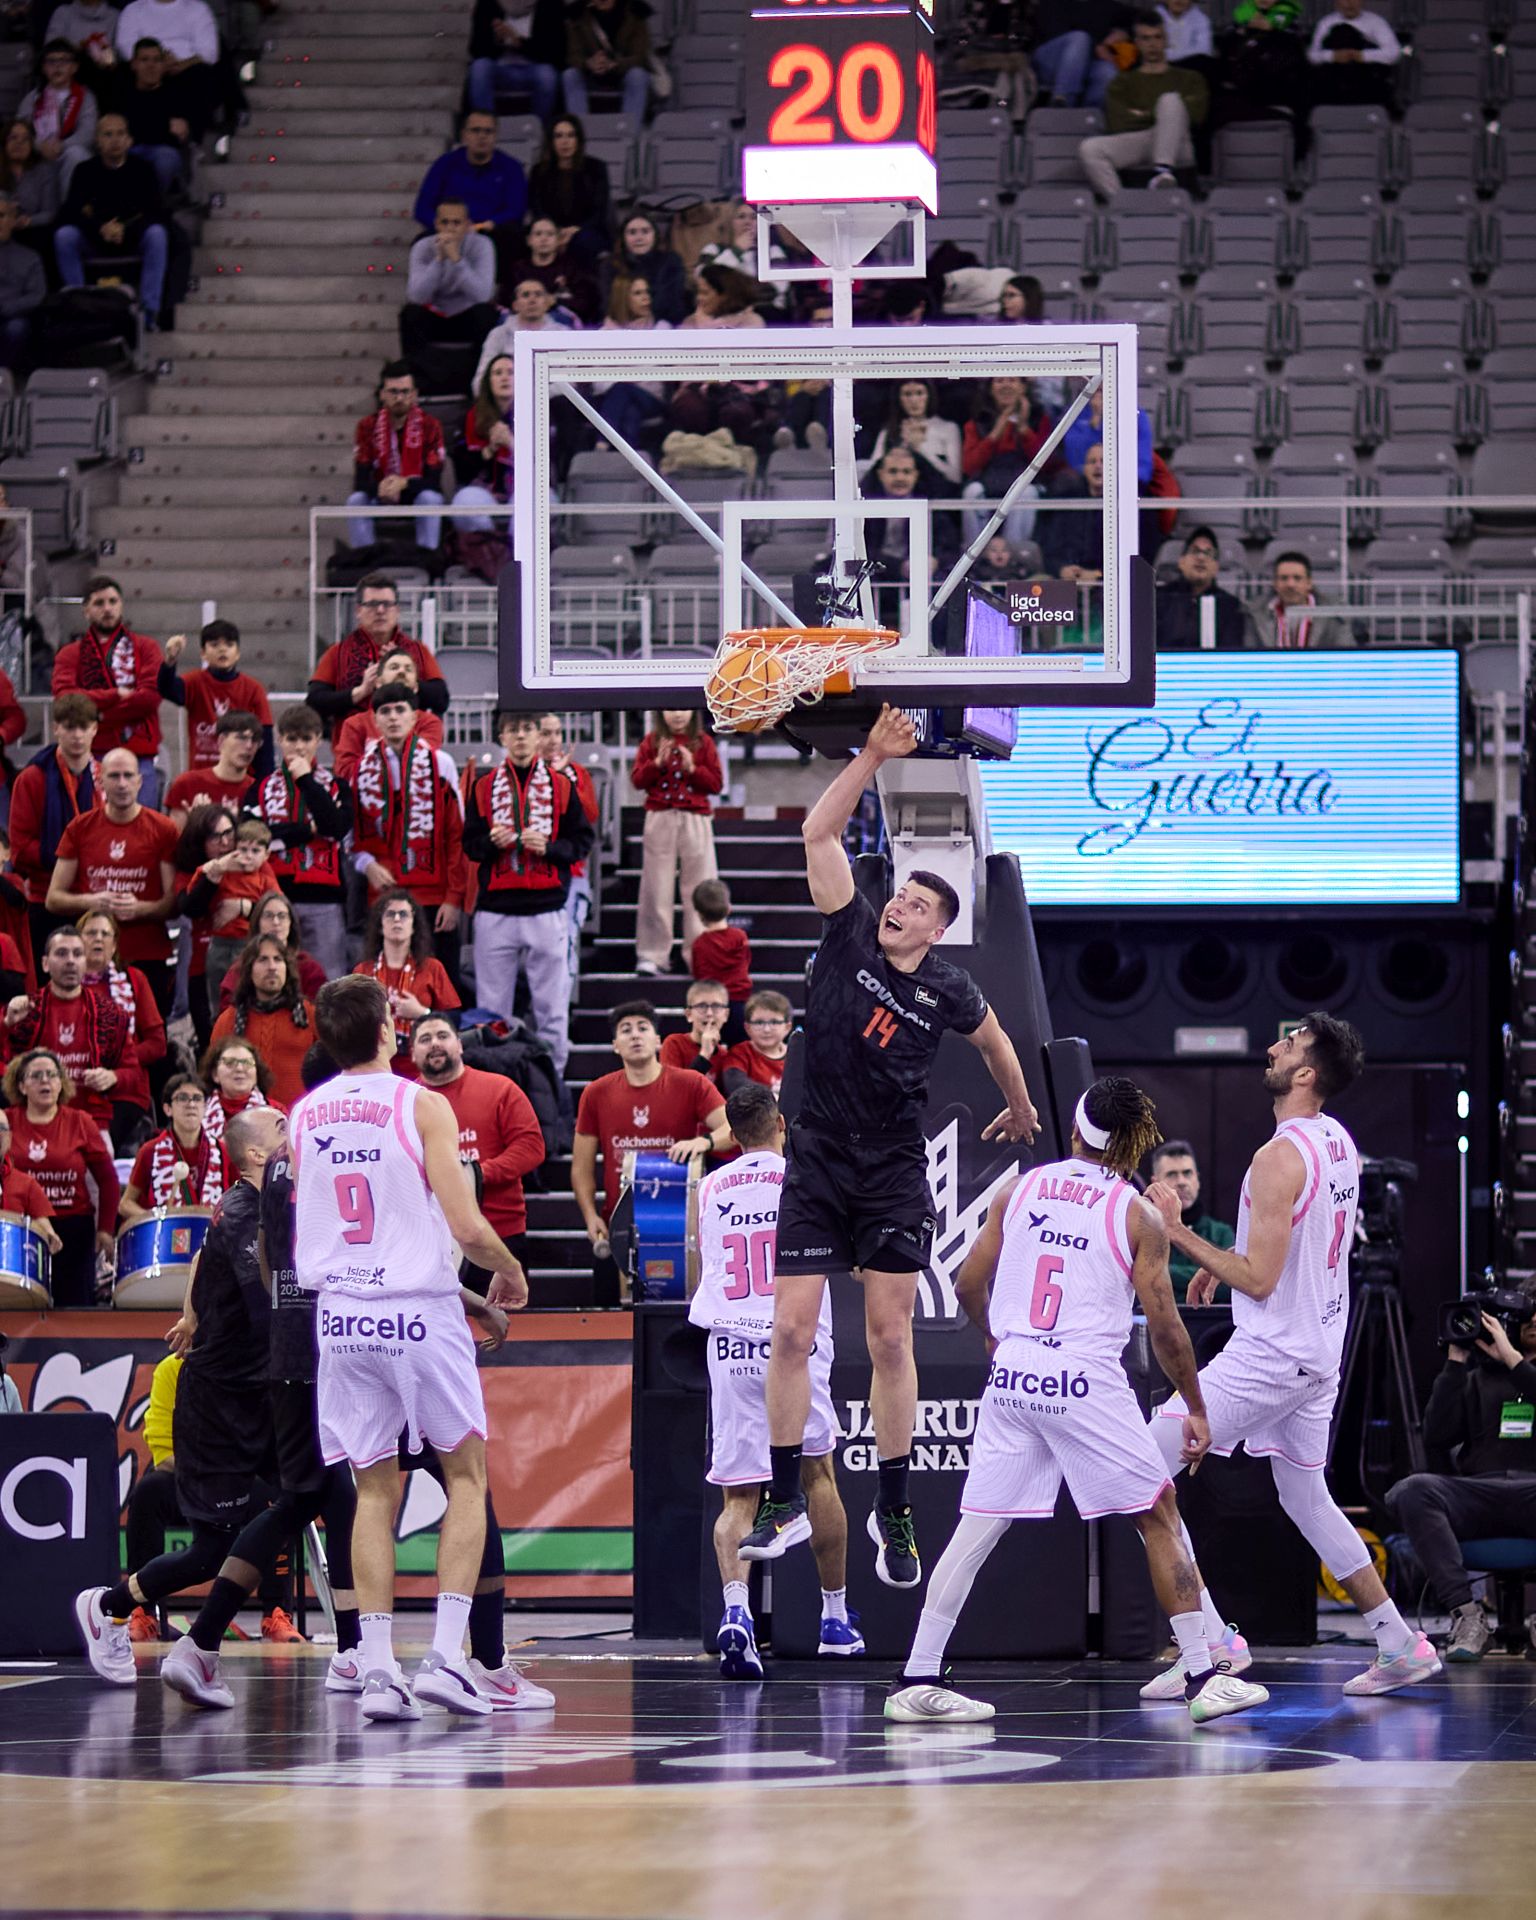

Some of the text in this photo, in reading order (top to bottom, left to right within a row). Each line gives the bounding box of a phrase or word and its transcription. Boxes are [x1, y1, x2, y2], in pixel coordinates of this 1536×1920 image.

[768, 41, 904, 144] 20
[1010, 593, 1040, 609] liga
[1010, 608, 1074, 622] endesa
[1077, 717, 1341, 856] Guerra
[862, 1006, 899, 1049] 14
[306, 1099, 392, 1131] BRUSSINO
[612, 1134, 675, 1148] Colchonería
[713, 1170, 785, 1195] ROBERTSON
[1037, 1178, 1106, 1209] ALBICY
[334, 1172, 375, 1245] 9
[722, 1229, 776, 1300] 30
[780, 1249, 799, 1257] vive
[347, 1266, 371, 1277] Islas
[1029, 1254, 1065, 1331] 6
[322, 1309, 427, 1342] Barceló
[331, 1344, 363, 1355] HOTEL
[729, 1367, 763, 1377] HOTEL
[987, 1361, 1089, 1398] Barceló
[993, 1396, 1068, 1416] HOTEL GROUP
